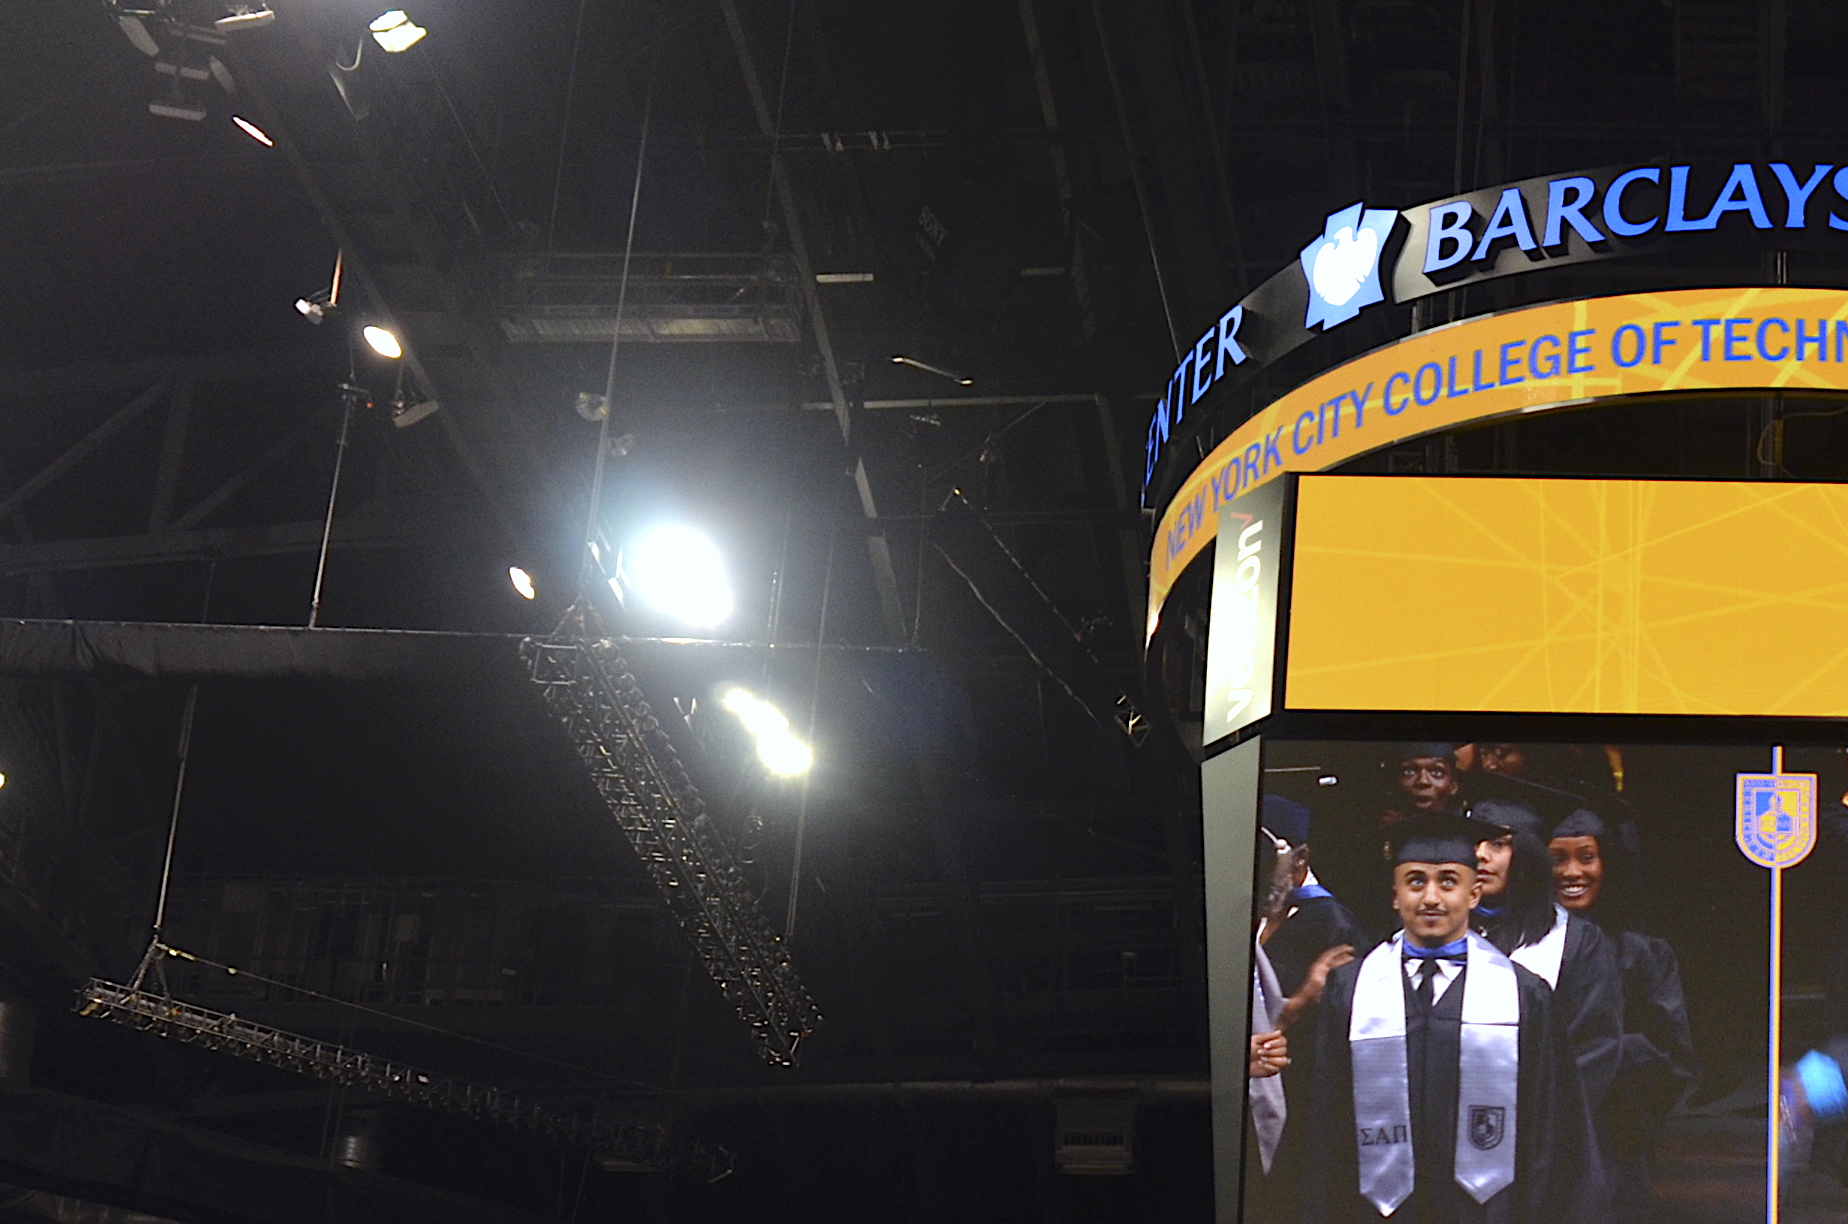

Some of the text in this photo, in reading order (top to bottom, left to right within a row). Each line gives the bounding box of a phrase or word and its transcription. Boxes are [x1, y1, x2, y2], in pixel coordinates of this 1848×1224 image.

[1140, 304, 1247, 508] ENTER
[1164, 497, 1207, 572] NEW
[1211, 427, 1284, 513] YORK
[1292, 382, 1375, 456] CITY
[1382, 329, 1597, 417] COLLEGE
[1611, 321, 1682, 369] OF
[1226, 520, 1263, 723] veon
